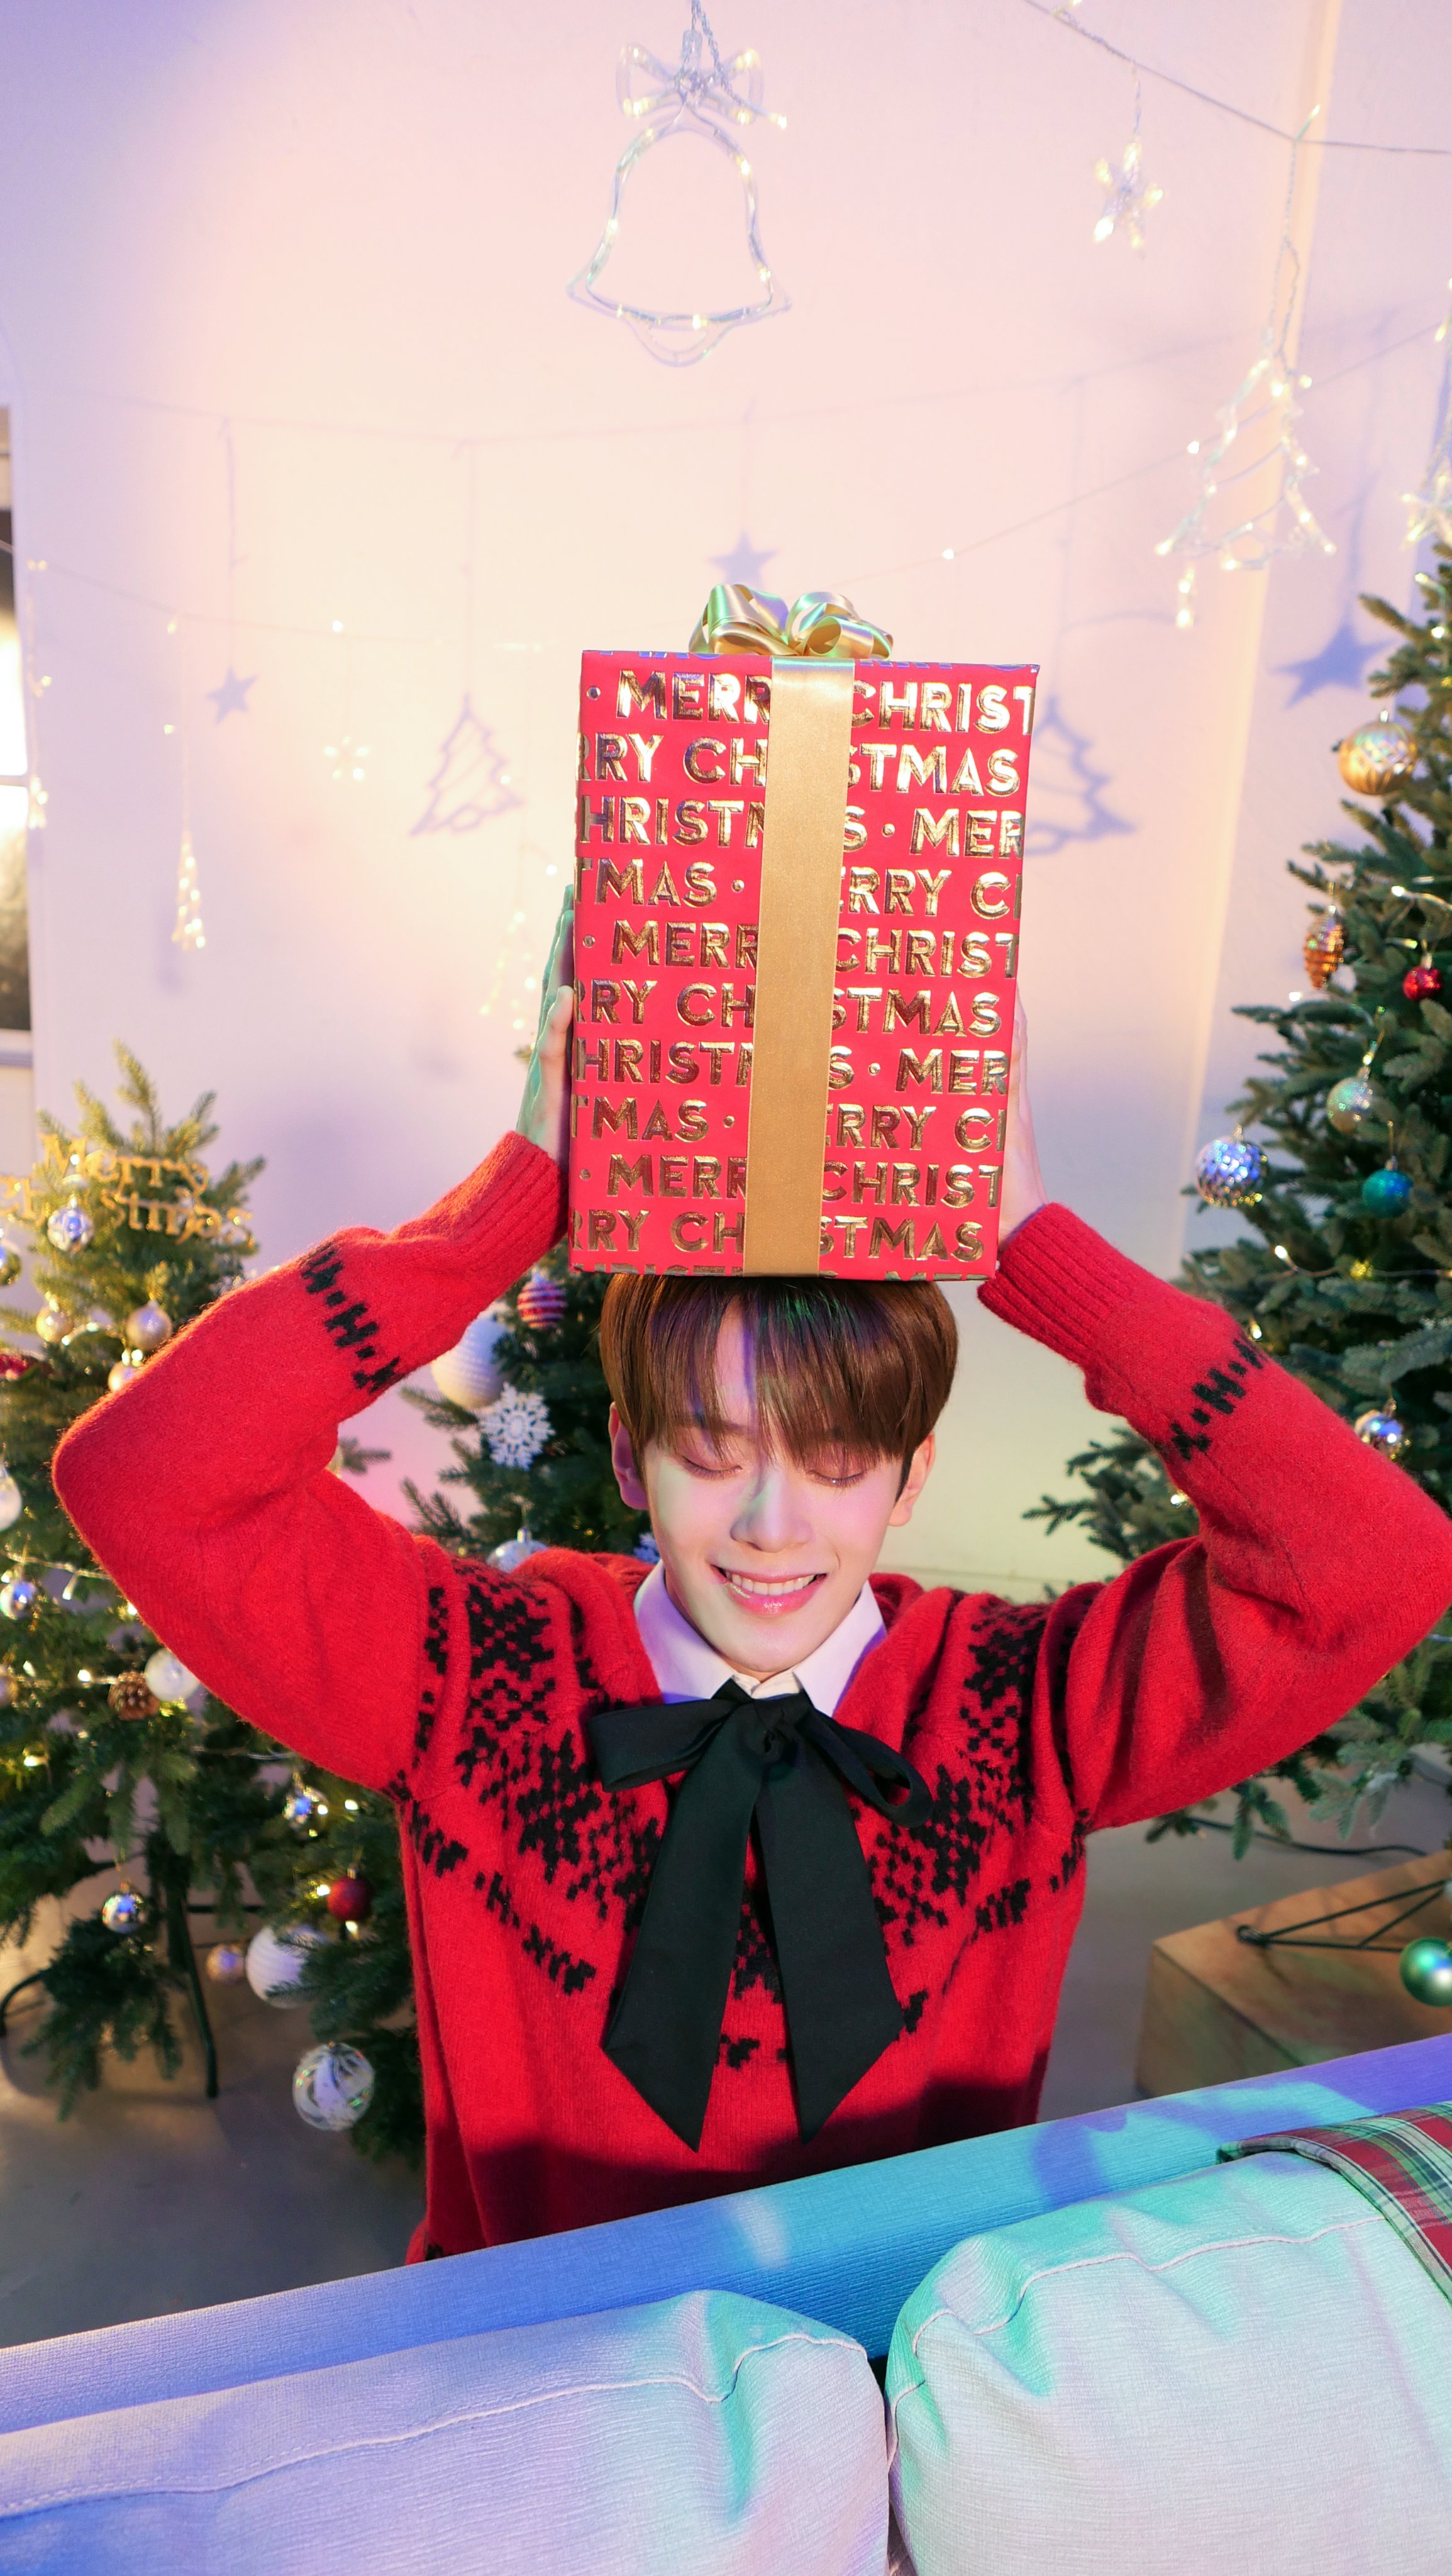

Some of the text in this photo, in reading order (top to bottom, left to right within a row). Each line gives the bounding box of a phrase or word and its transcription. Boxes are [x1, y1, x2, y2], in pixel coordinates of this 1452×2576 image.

[614, 668, 771, 725] MERR
[682, 735, 1021, 799] CHTMAS
[840, 864, 953, 918] RRY
[969, 870, 1023, 922] C
[610, 918, 758, 970] MERR
[675, 981, 1004, 1039] CHTMAS
[826, 1102, 938, 1152] RRY
[953, 1107, 1008, 1154] C
[38, 1131, 209, 1195] Merry
[606, 1153, 747, 1199] MERR
[669, 1210, 987, 1264] CHTMAS
